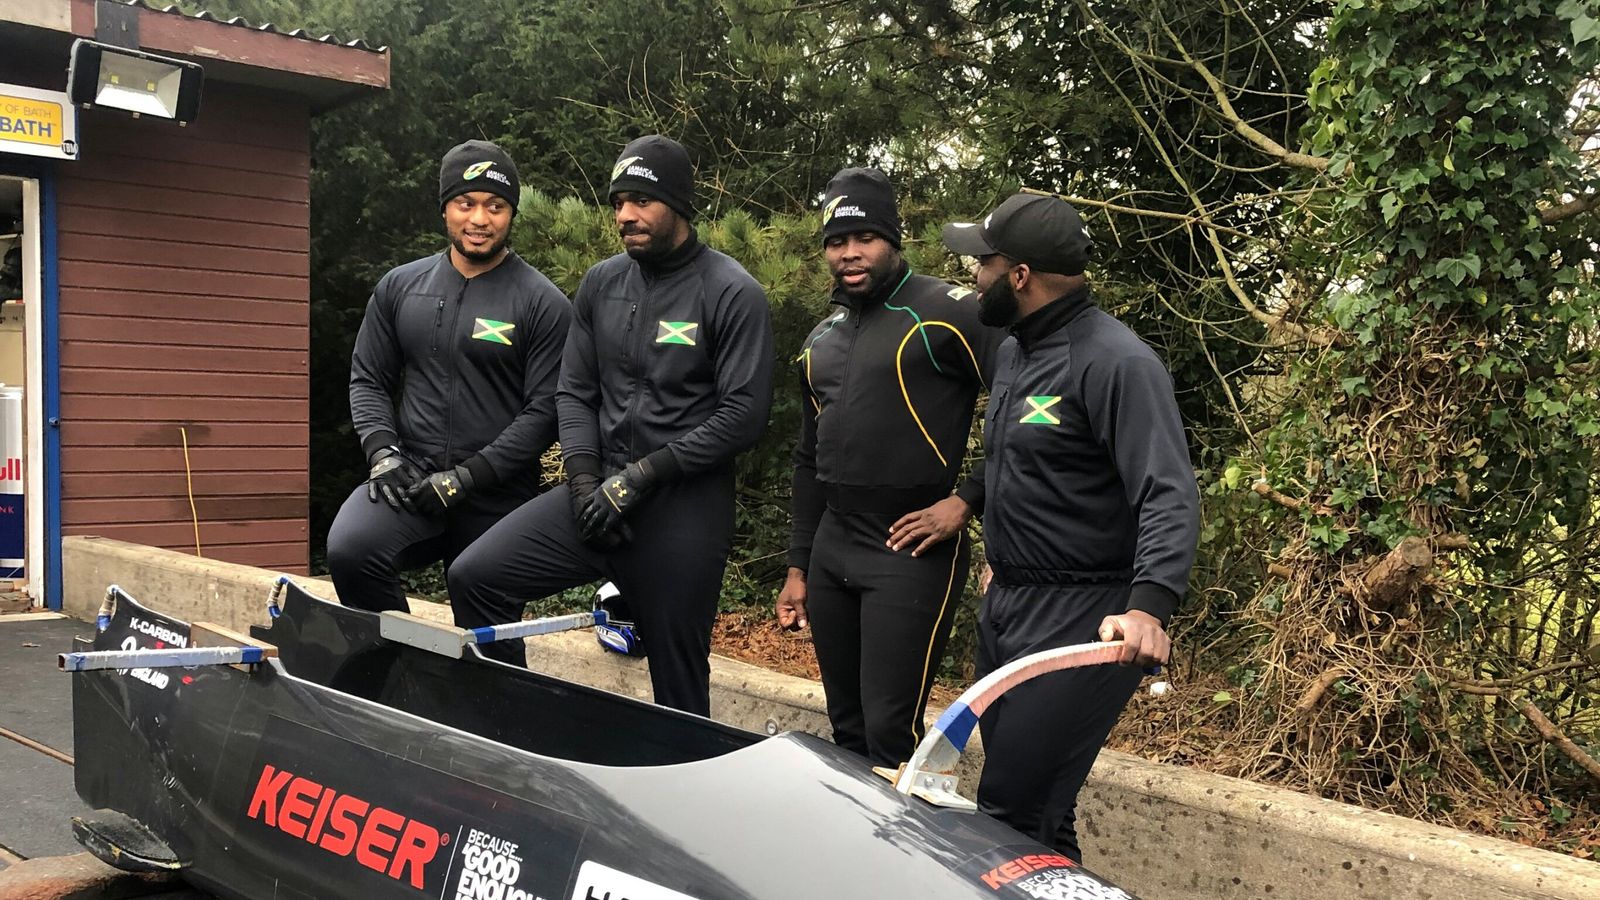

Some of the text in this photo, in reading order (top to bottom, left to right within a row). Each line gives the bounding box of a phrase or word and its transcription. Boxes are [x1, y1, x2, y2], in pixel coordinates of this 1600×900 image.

[5, 103, 19, 114] OF
[23, 106, 51, 118] BATH
[129, 616, 188, 649] K-CARBON
[247, 764, 440, 890] KEISER
